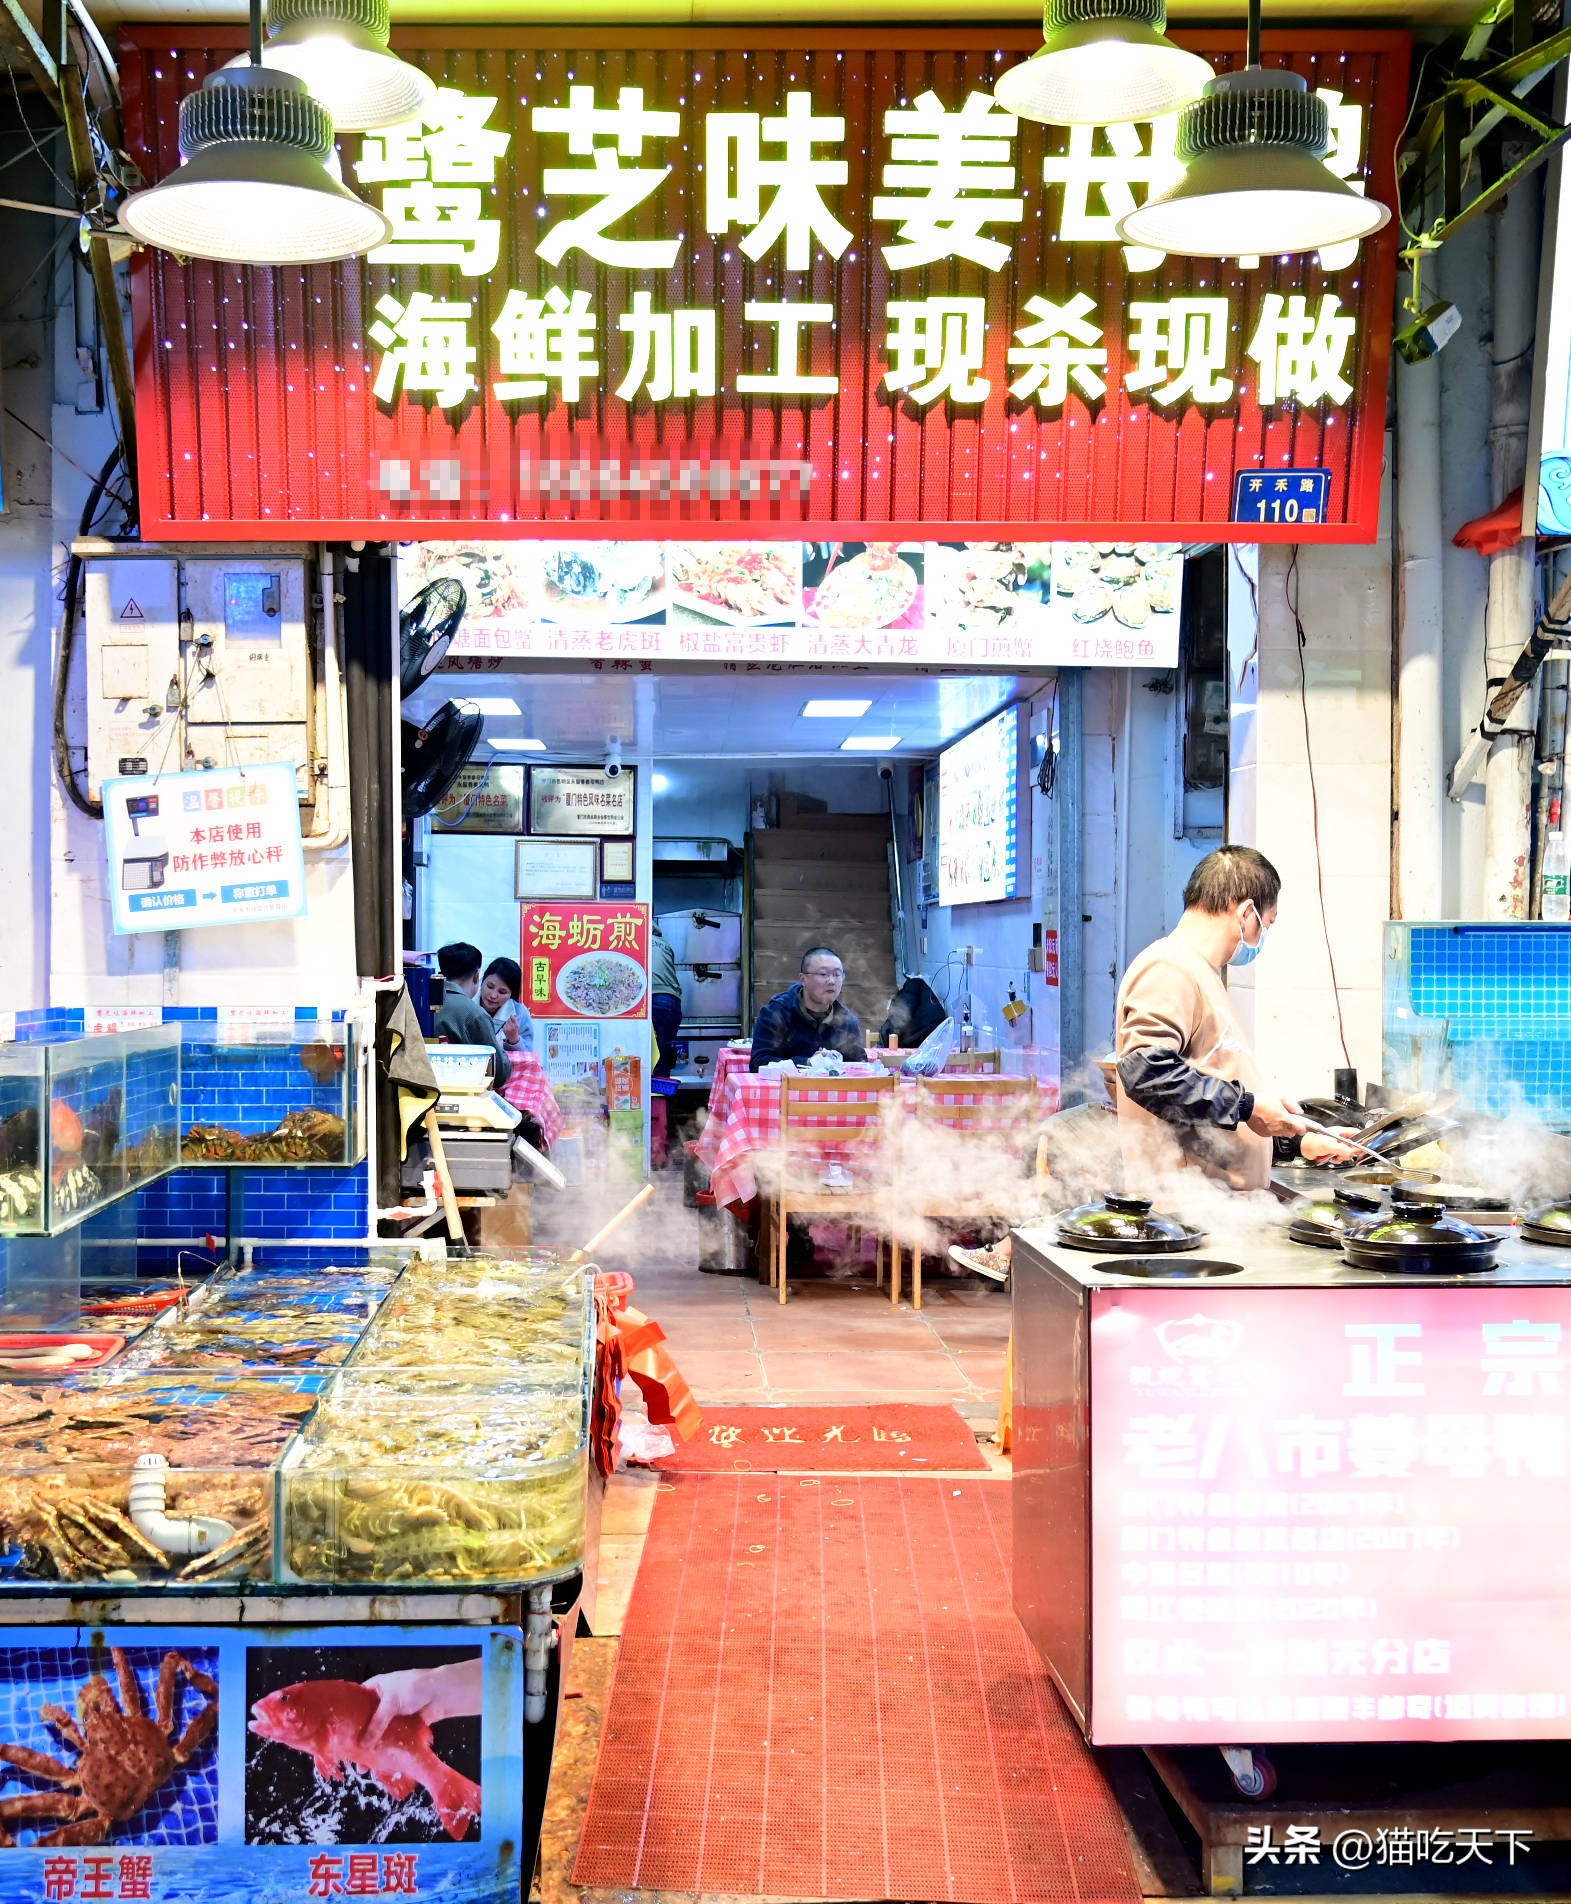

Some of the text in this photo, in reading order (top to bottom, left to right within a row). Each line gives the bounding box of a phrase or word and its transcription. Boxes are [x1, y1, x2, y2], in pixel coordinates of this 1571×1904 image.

[368, 286, 1357, 408] 海鲜加工 现杀现做
[1249, 478, 1315, 492] 开禾路
[1257, 498, 1299, 522] 110
[547, 629, 661, 652] 清蒸老虎斑
[190, 822, 262, 845] 本店使用
[173, 846, 284, 872] 防作弊放心秤
[528, 911, 643, 950] 海蛎煎
[533, 960, 547, 998] 古早味
[1342, 1319, 1566, 1396] 正宗
[44, 1854, 153, 1900] 帝王蟹
[307, 1853, 419, 1897] 东星斑
